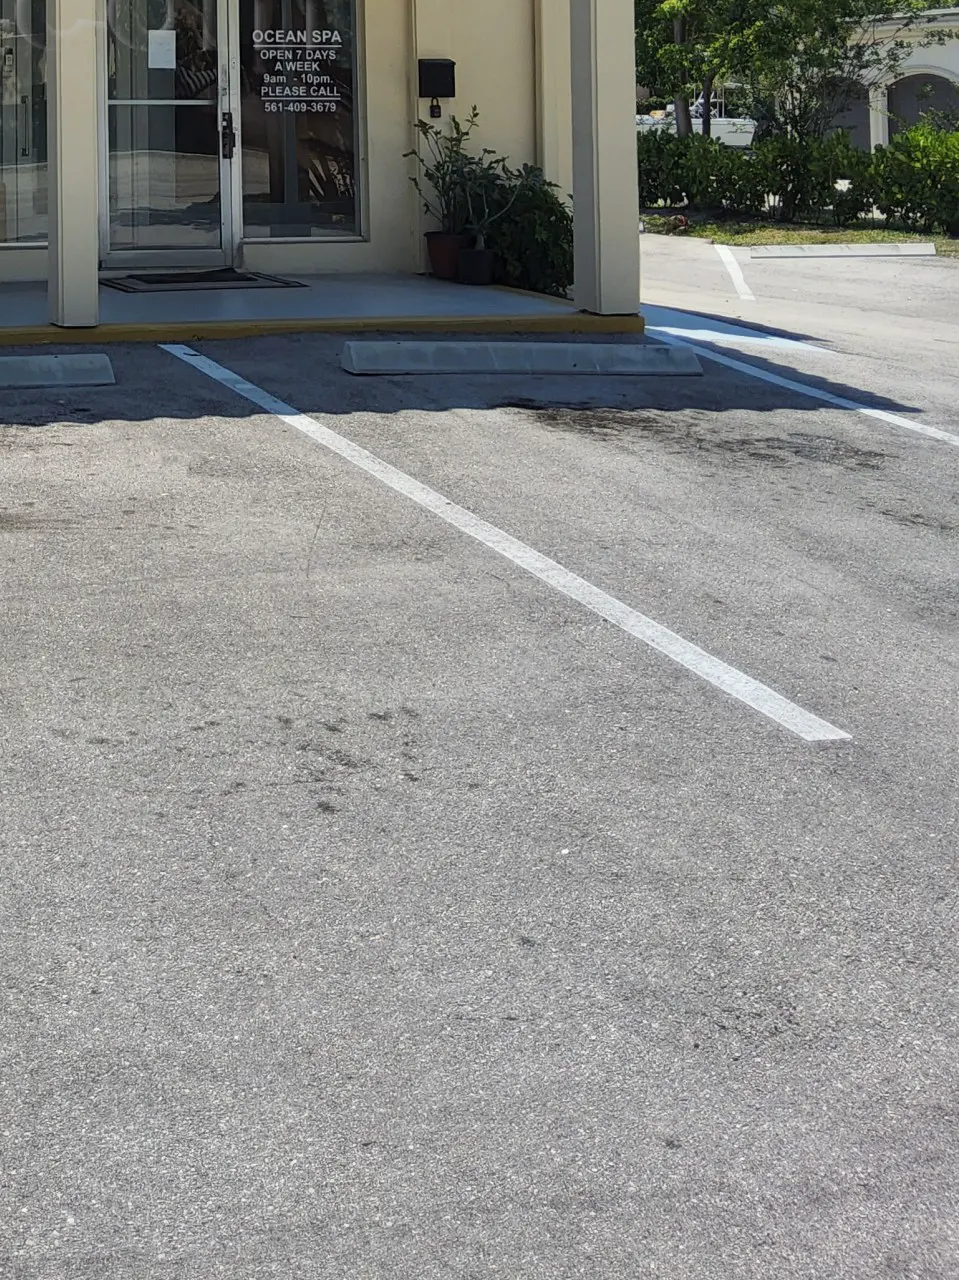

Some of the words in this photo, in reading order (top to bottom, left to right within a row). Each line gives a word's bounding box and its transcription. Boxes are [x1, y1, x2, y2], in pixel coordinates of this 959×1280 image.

[252, 29, 307, 43] OCEAN
[311, 29, 342, 43] SPA
[259, 49, 293, 60] OPEN
[296, 50, 302, 60] 7
[305, 49, 337, 60] DAYS
[274, 61, 283, 71] A
[285, 61, 320, 71] WEEK
[263, 73, 287, 84] 9am
[301, 73, 333, 85] 10pm.
[261, 86, 307, 97] PLEASE
[309, 86, 341, 97] CALL
[264, 102, 337, 113] 561-409-3679
